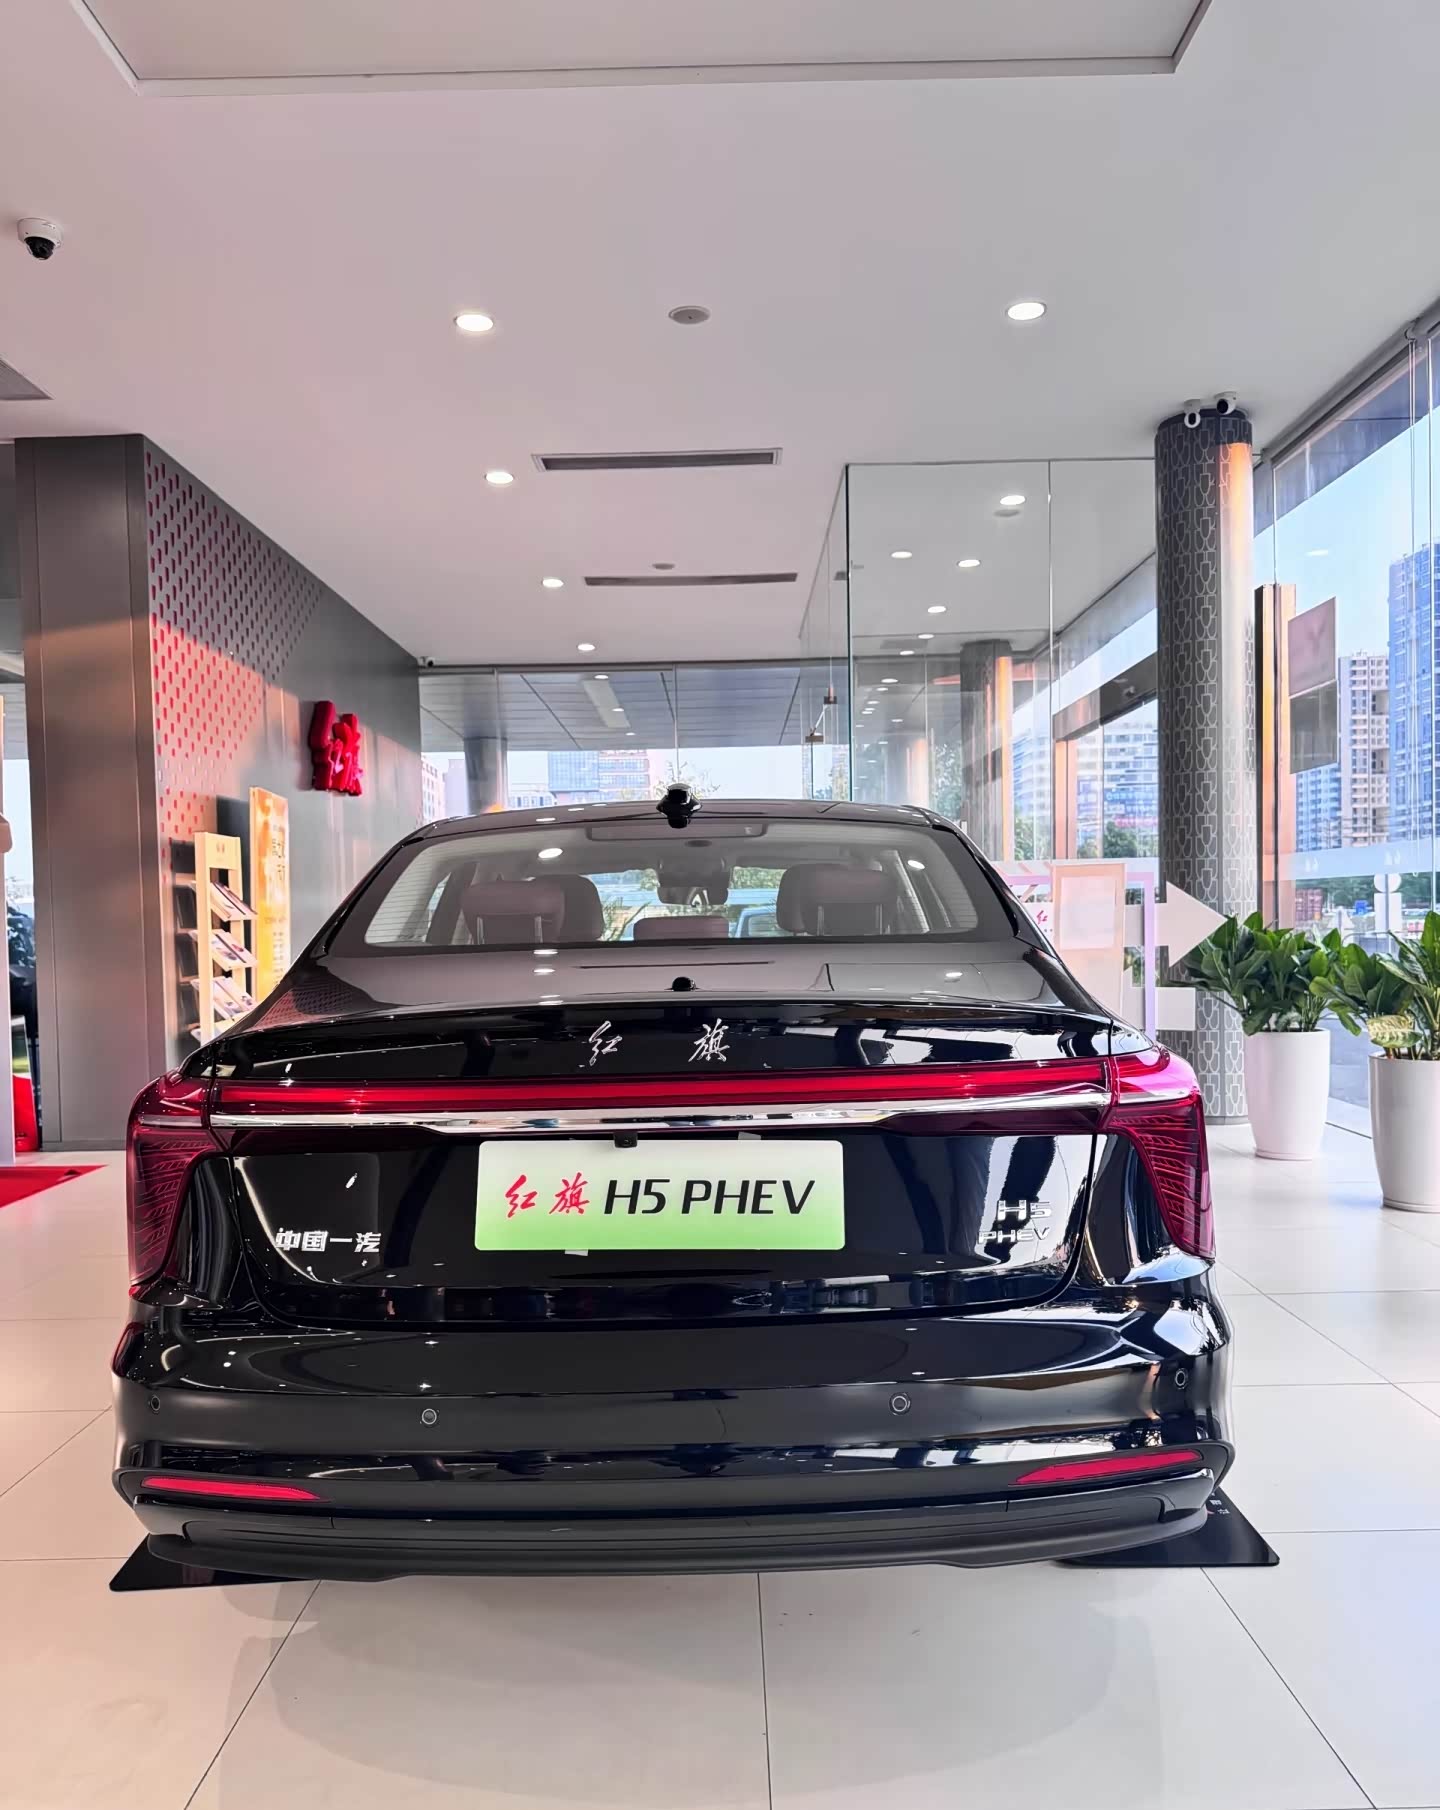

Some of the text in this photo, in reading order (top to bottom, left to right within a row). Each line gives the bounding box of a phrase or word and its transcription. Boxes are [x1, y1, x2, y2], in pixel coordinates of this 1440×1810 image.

[505, 1172, 816, 1218] 红旗 H5 PHEV
[997, 1200, 1052, 1220] H5
[274, 1229, 382, 1253] 中国一汽
[977, 1226, 1050, 1244] PHEV
